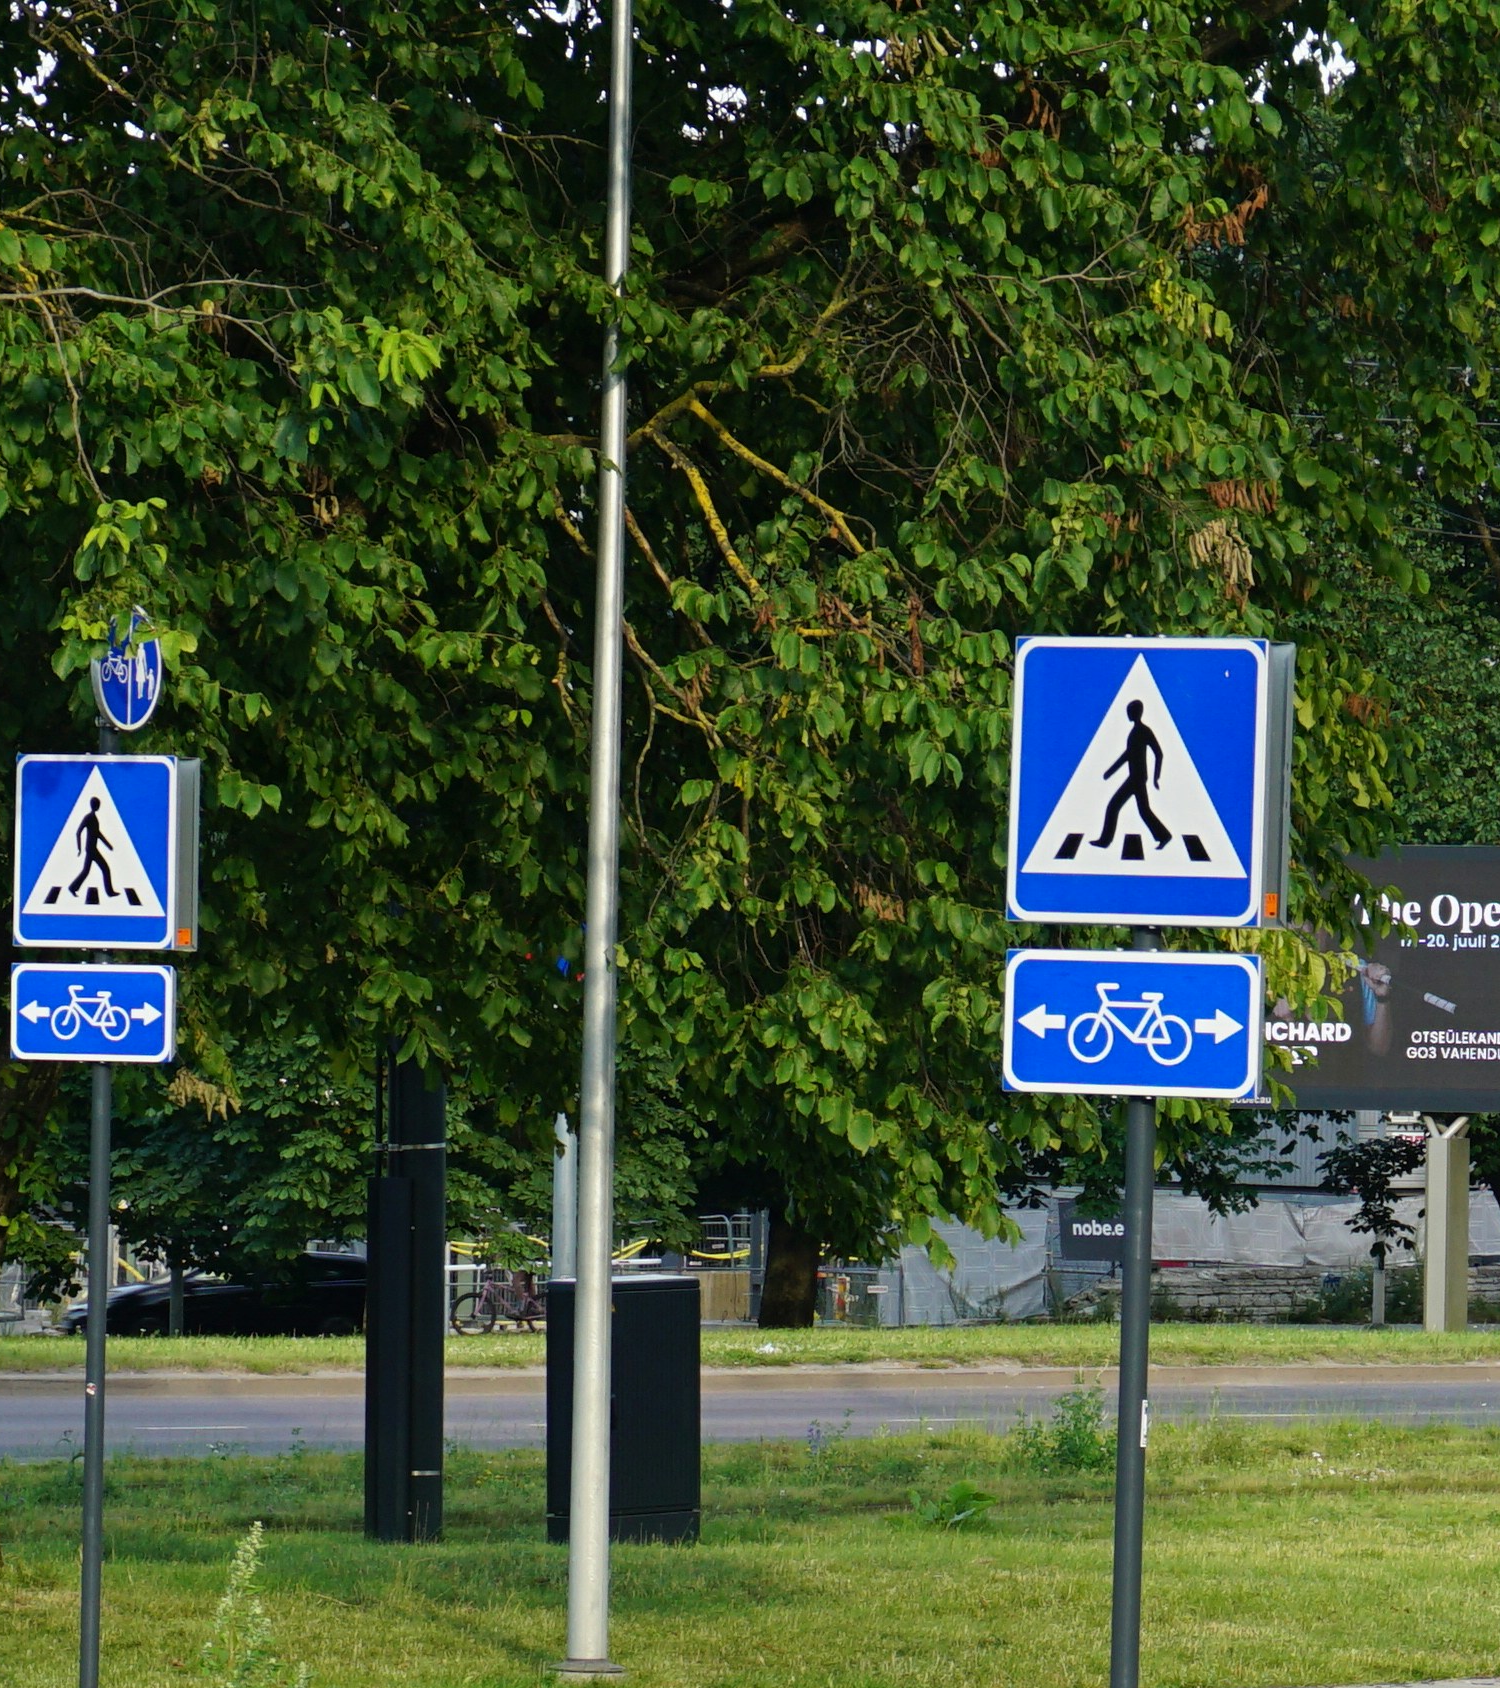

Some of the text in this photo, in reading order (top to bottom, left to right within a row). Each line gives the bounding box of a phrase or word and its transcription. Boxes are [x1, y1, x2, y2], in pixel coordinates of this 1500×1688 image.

[1453, 934, 1486, 951] juuli
[1265, 1022, 1352, 1042] ICHARD
[1406, 1047, 1437, 1059] GO3
[1072, 1219, 1125, 1236] nobe.e
